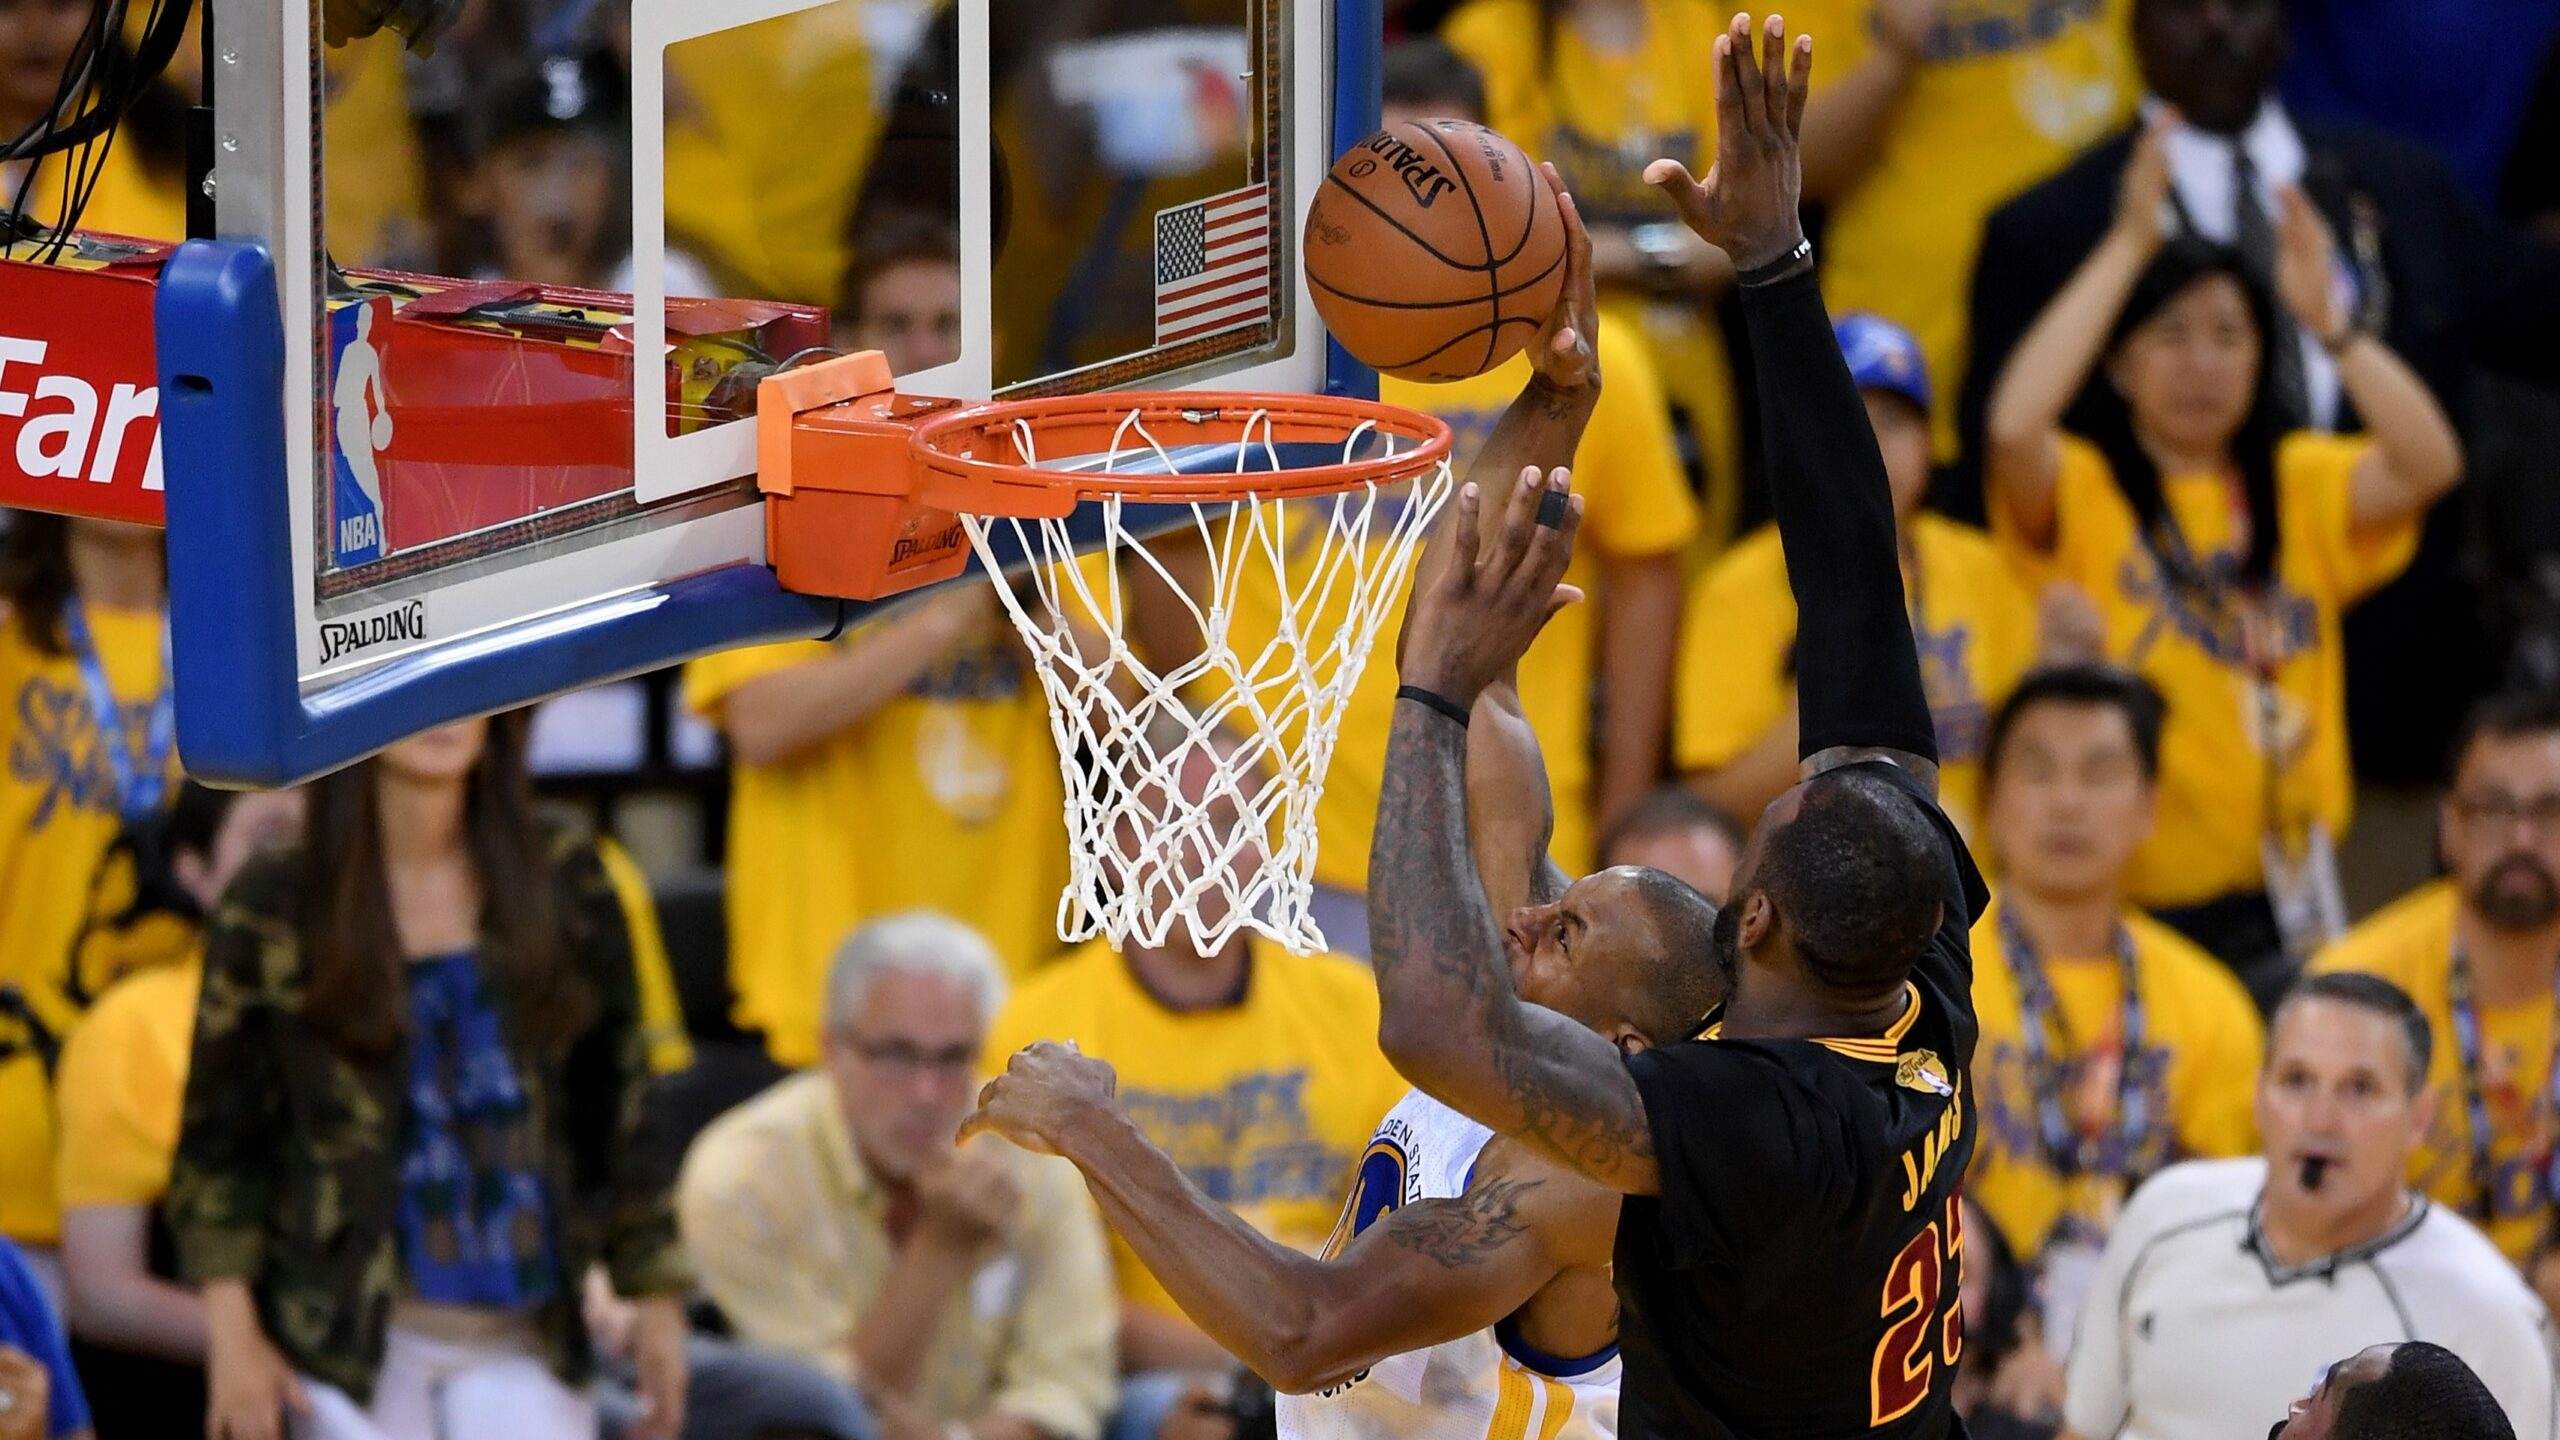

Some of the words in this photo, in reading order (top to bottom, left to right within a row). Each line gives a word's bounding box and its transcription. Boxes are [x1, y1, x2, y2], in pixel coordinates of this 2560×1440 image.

[1359, 131, 1457, 209] SPALD
[0, 336, 165, 491] Far
[340, 511, 377, 554] NBA
[889, 522, 964, 567] SPALDING
[320, 600, 425, 665] SPALDING
[1368, 1119, 1414, 1147] LDEN
[1408, 1143, 1423, 1200] STAT
[1901, 1068, 1963, 1212] JAMS
